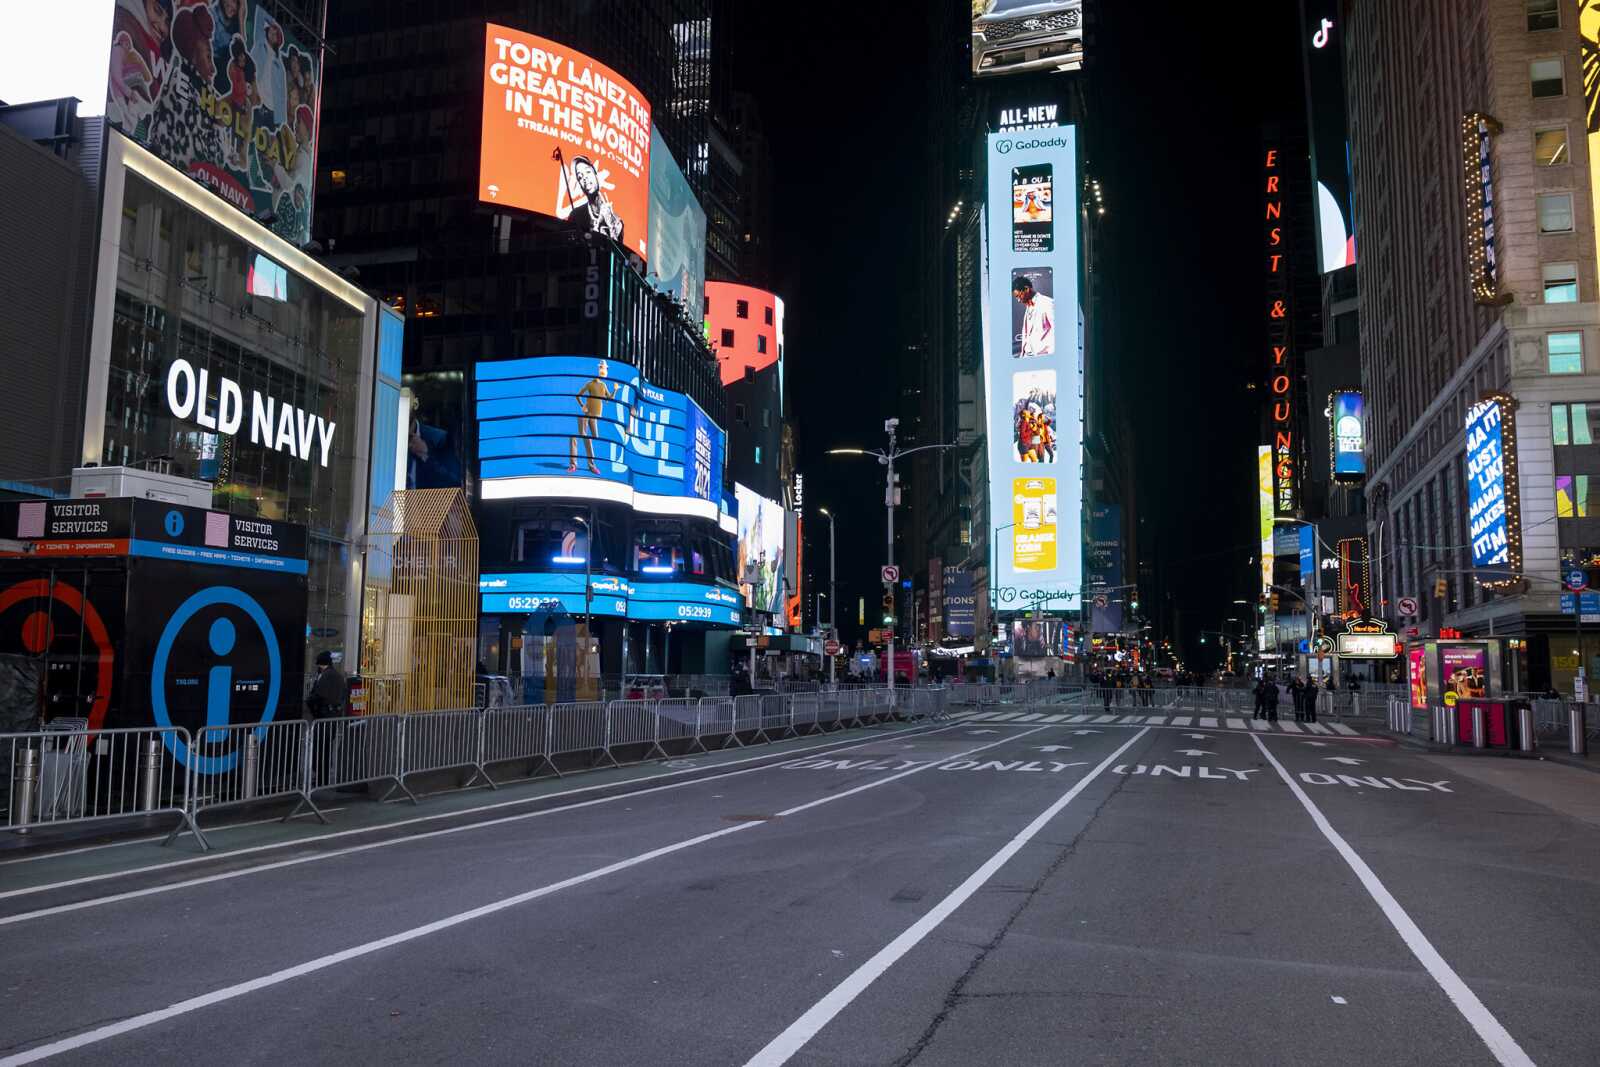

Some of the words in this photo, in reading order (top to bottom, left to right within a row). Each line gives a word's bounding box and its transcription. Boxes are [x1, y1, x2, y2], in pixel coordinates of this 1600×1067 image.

[494, 38, 563, 75] TORY
[568, 61, 627, 107] LANEZ
[628, 95, 649, 130] THE
[490, 63, 606, 118] GREATEST
[610, 106, 650, 153] ARTIST
[505, 90, 532, 116] IN
[538, 98, 584, 133] THE
[1000, 104, 1057, 125] ALL-NEW
[517, 118, 559, 139] STREAM
[560, 129, 582, 146] NOW
[1016, 137, 1067, 150] GoDaddy
[220, 182, 249, 207] NAVY
[1265, 150, 1283, 273] ERNST
[585, 248, 600, 318] 1500
[1270, 300, 1286, 318] &
[167, 358, 242, 436] OLD
[250, 390, 336, 468] NAVY
[1273, 347, 1293, 480] YOUNG
[1468, 439, 1497, 480] JUST
[793, 473, 802, 506] Locker
[53, 504, 101, 517] VISITOR
[1469, 483, 1502, 520] MAMA
[52, 521, 108, 534] SERVICES
[235, 519, 273, 536] VISITOR
[234, 535, 279, 551] SERVICES
[1019, 589, 1074, 602] GoDaddy
[780, 759, 932, 770] ONLY
[938, 760, 1089, 772] ONLY
[1111, 764, 1262, 780] ONLY
[1299, 772, 1454, 792] ONLY
